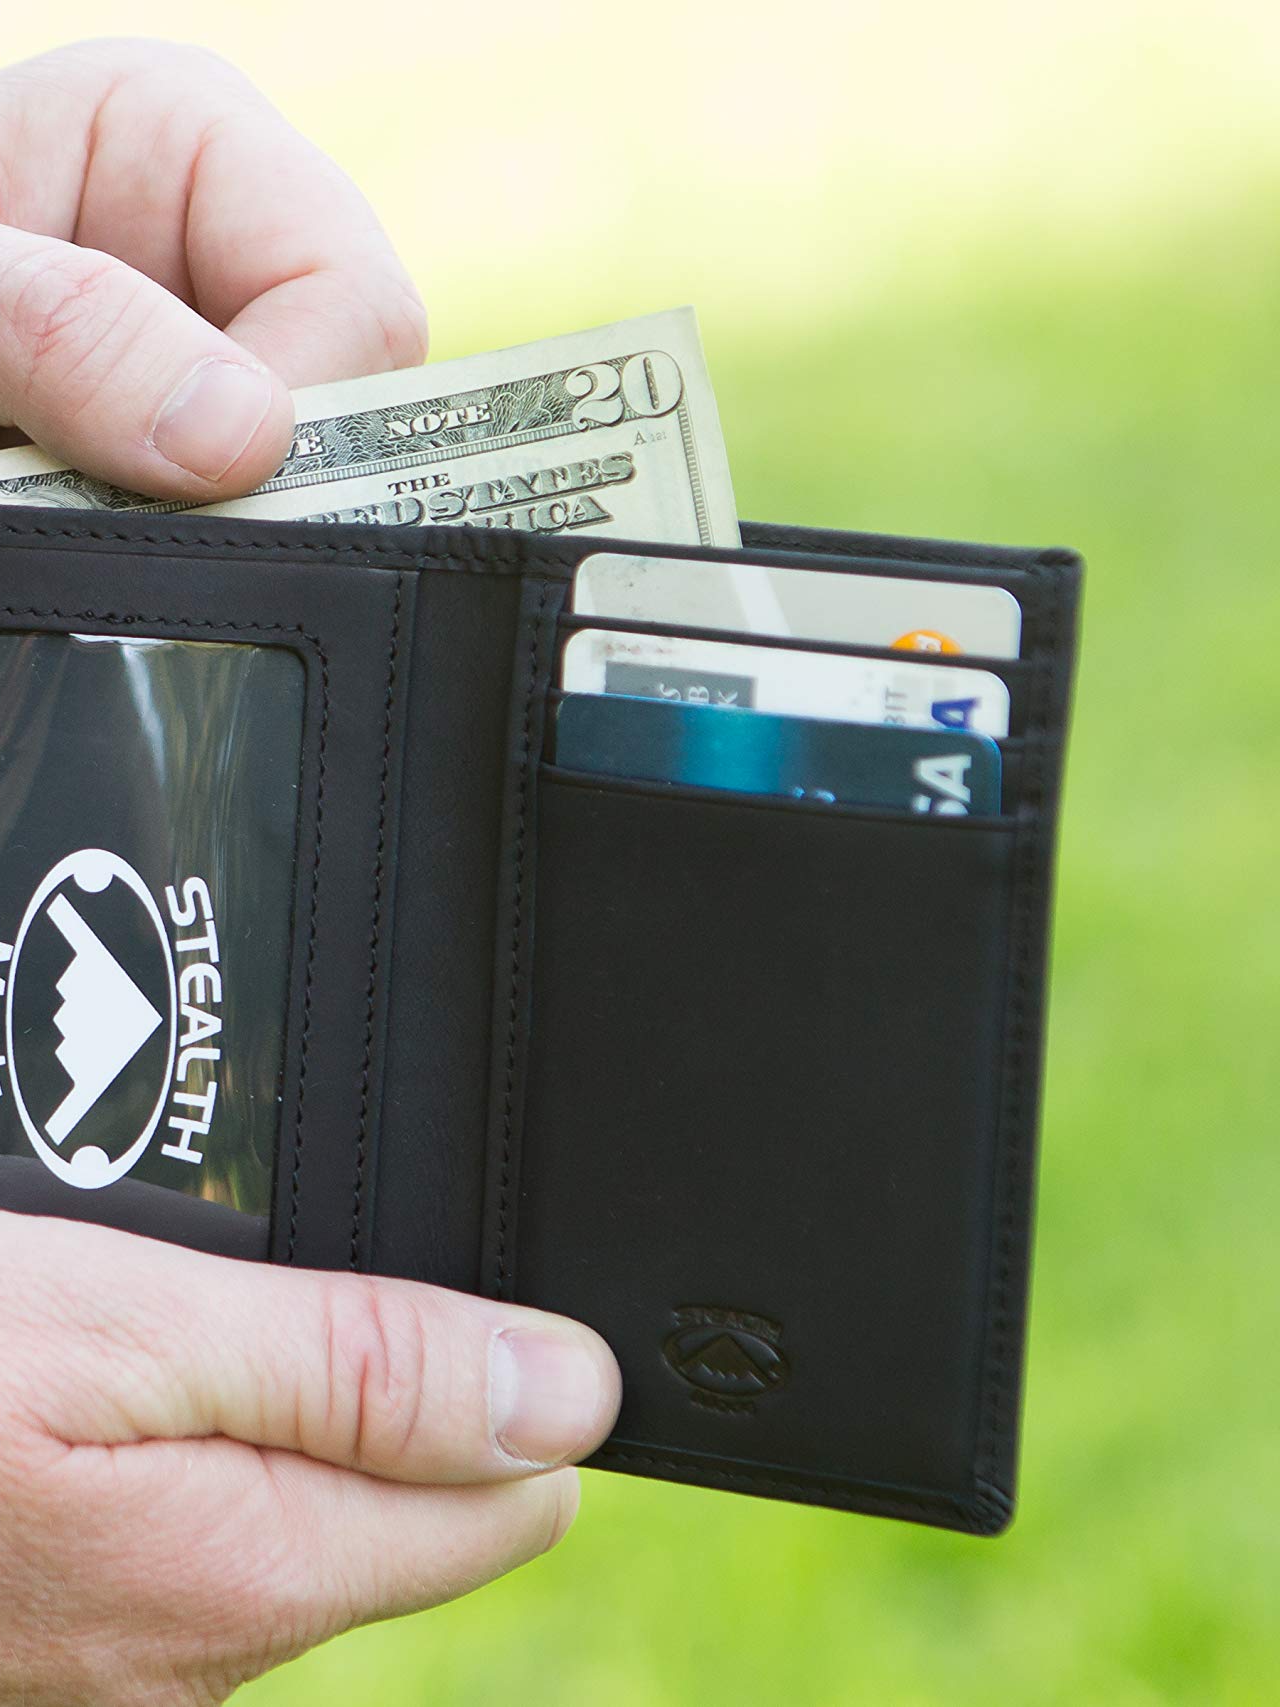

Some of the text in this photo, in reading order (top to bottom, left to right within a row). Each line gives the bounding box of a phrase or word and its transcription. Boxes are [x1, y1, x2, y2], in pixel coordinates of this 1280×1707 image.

[564, 350, 684, 432] 20
[384, 403, 495, 441] NOTE
[388, 472, 451, 497] THE
[161, 876, 223, 1164] STEALTH
